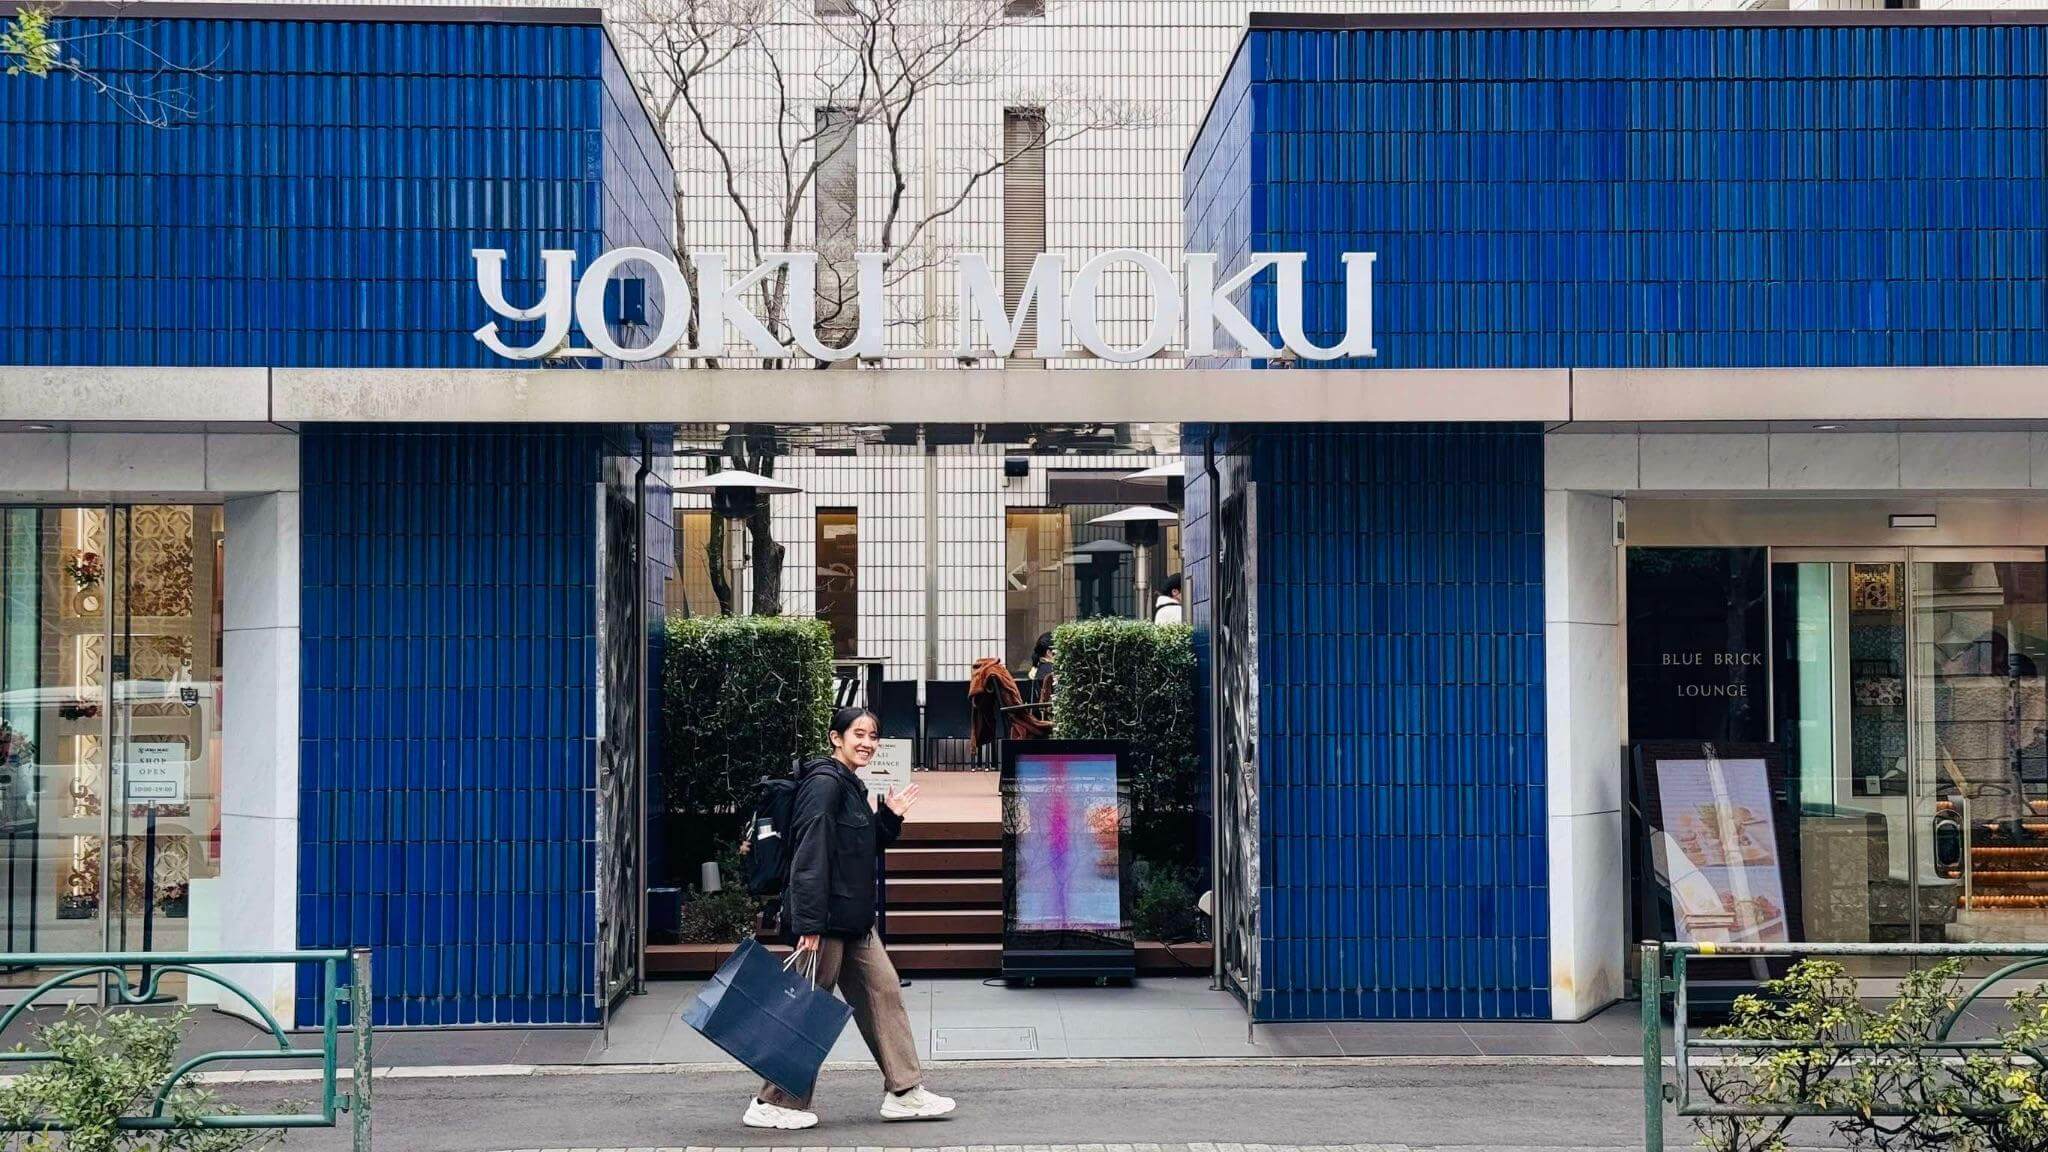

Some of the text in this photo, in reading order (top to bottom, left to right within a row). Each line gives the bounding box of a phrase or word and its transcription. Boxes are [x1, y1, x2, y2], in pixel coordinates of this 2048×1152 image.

[472, 247, 1377, 362] YOKU MOKU
[1662, 653, 1762, 665] BLUE BRICK
[1678, 685, 1747, 697] LOUNGE
